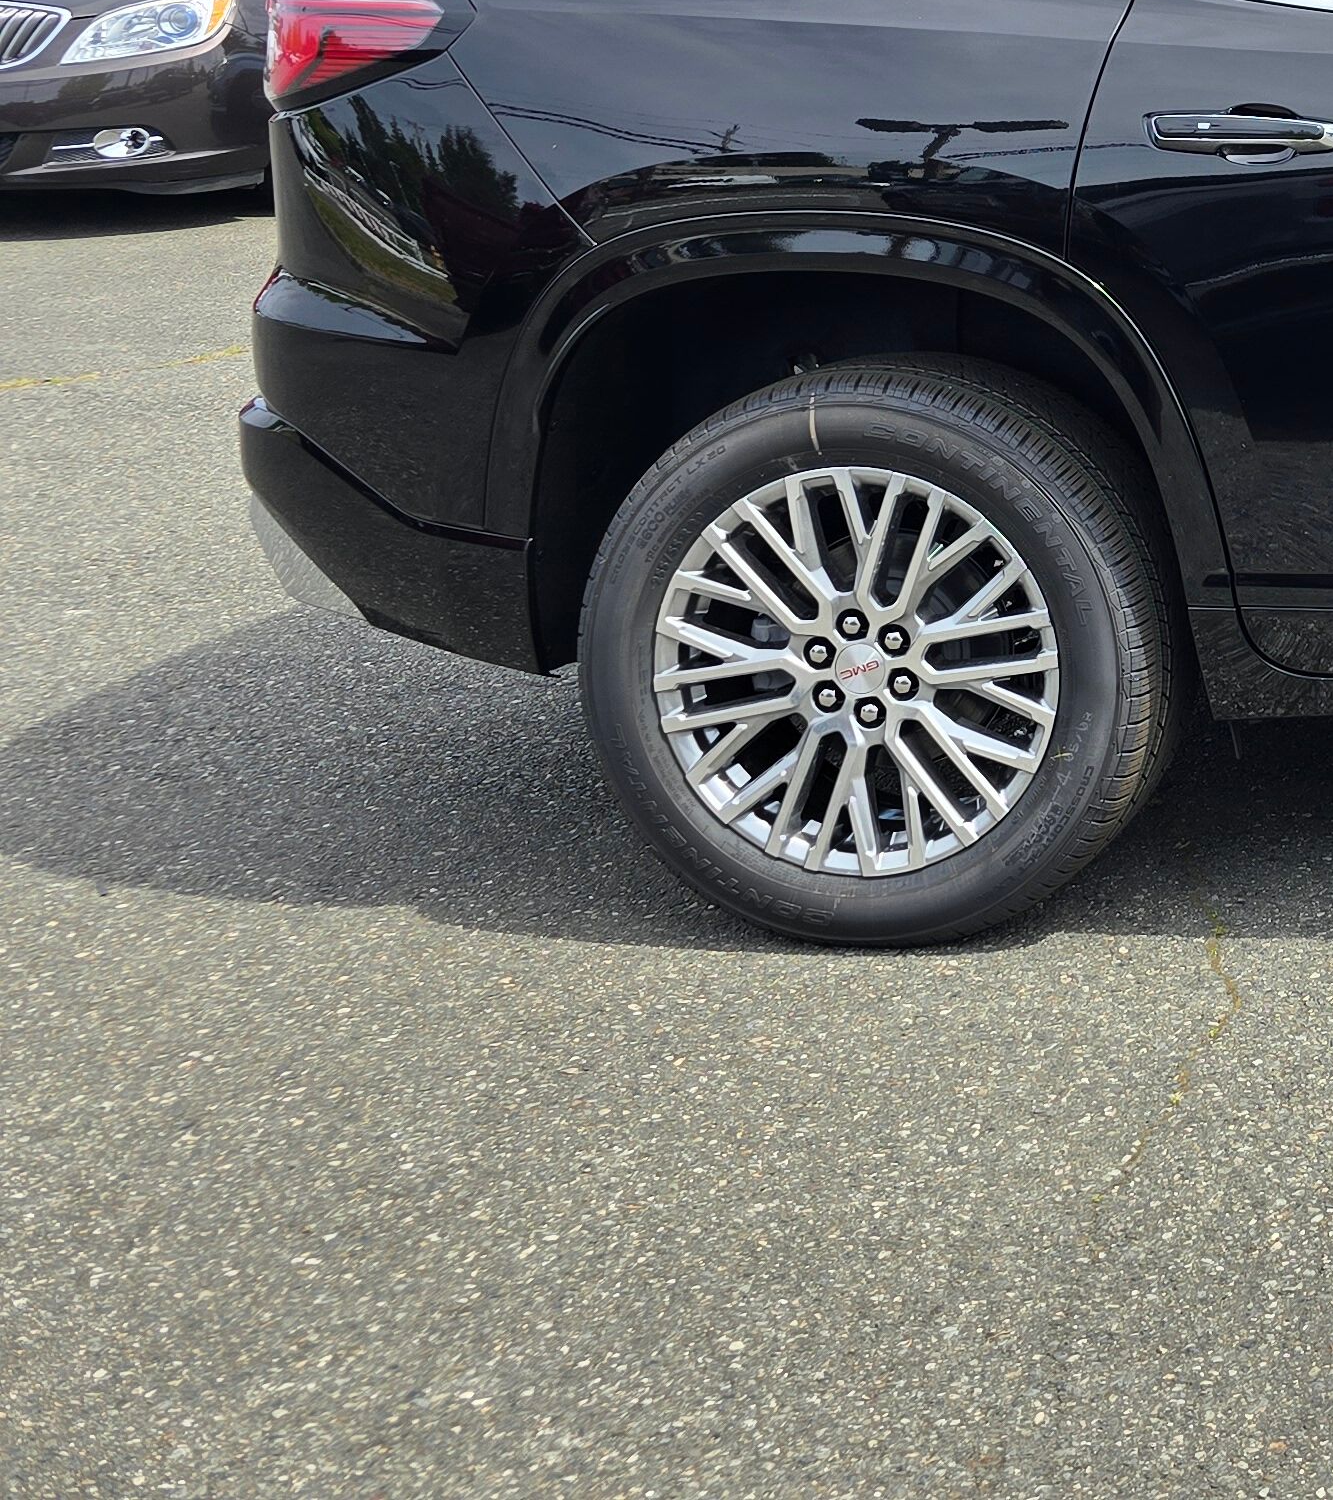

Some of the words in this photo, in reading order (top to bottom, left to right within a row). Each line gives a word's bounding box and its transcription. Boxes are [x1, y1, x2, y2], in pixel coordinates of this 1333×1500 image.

[862, 422, 1094, 627] CONTINENTAL
[839, 660, 880, 680] GMC
[610, 722, 835, 927] CONTINENTAL
